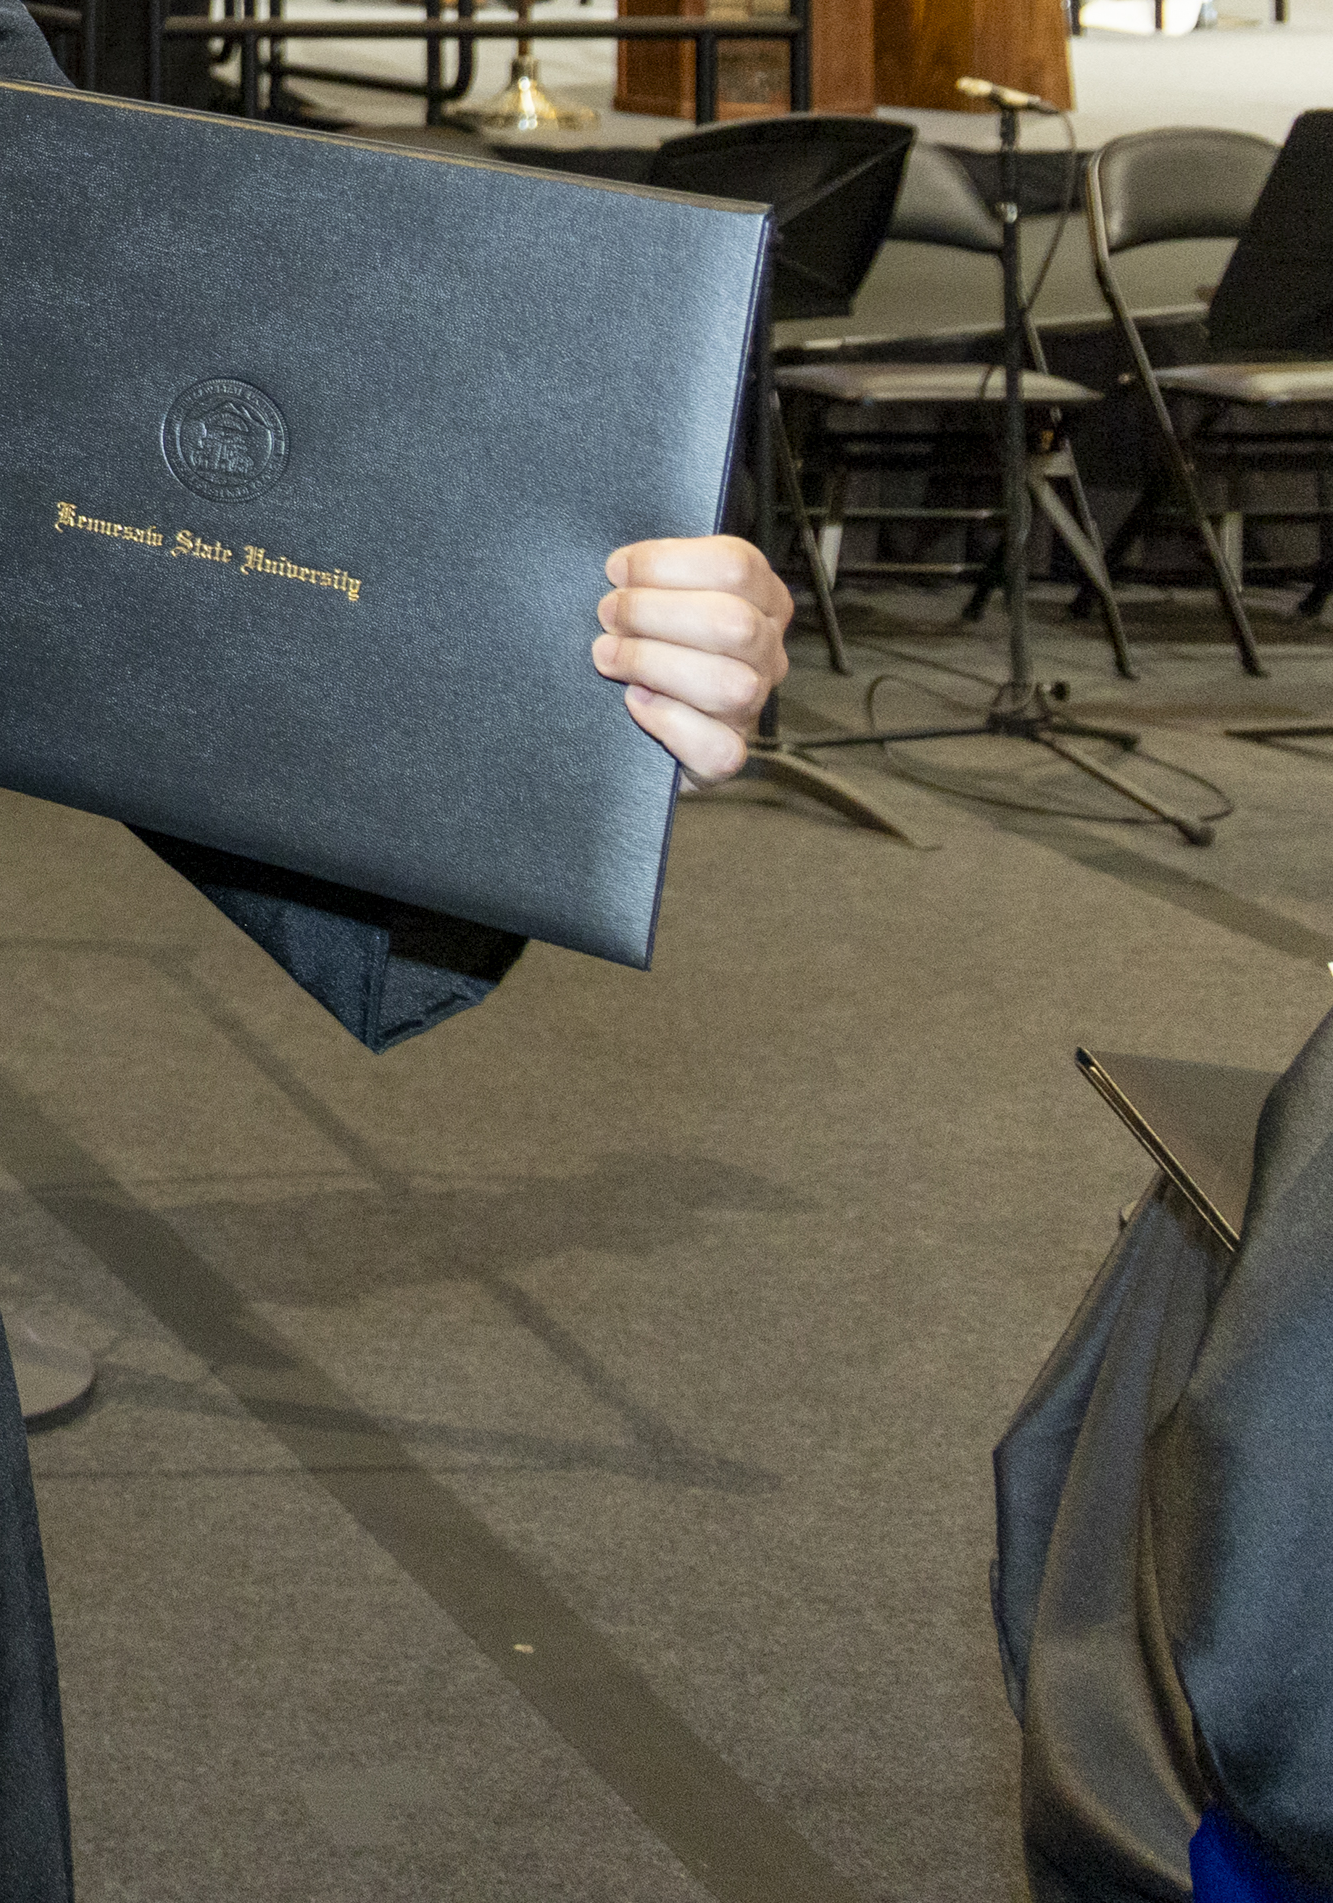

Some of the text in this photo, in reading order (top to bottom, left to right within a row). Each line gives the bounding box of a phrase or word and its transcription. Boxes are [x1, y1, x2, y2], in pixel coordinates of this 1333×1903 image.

[55, 501, 362, 601] Kennesaw State University
